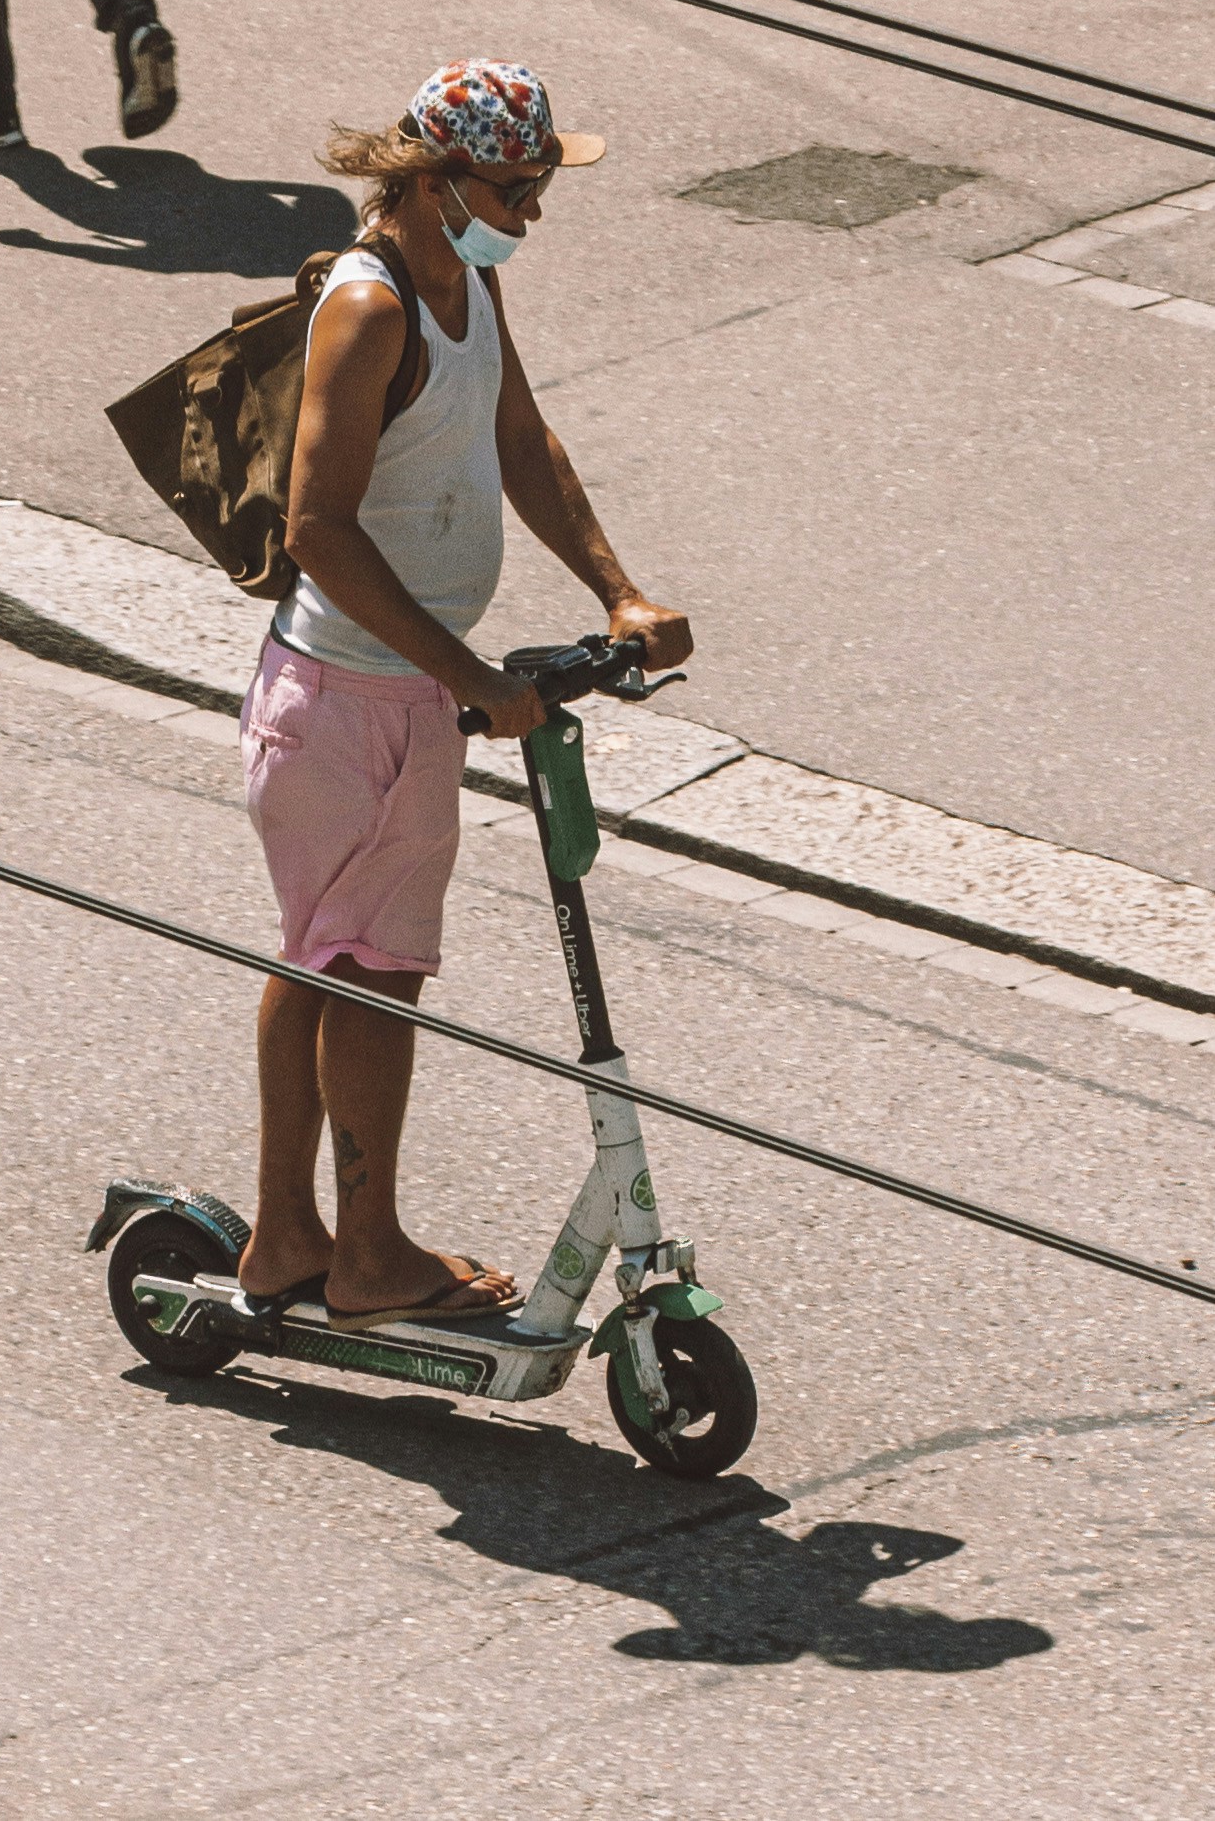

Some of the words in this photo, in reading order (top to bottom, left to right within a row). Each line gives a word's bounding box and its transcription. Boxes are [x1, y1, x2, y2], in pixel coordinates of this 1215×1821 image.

[556, 904, 571, 931] On
[562, 934, 579, 978] Lime
[574, 994, 592, 1038] Uber
